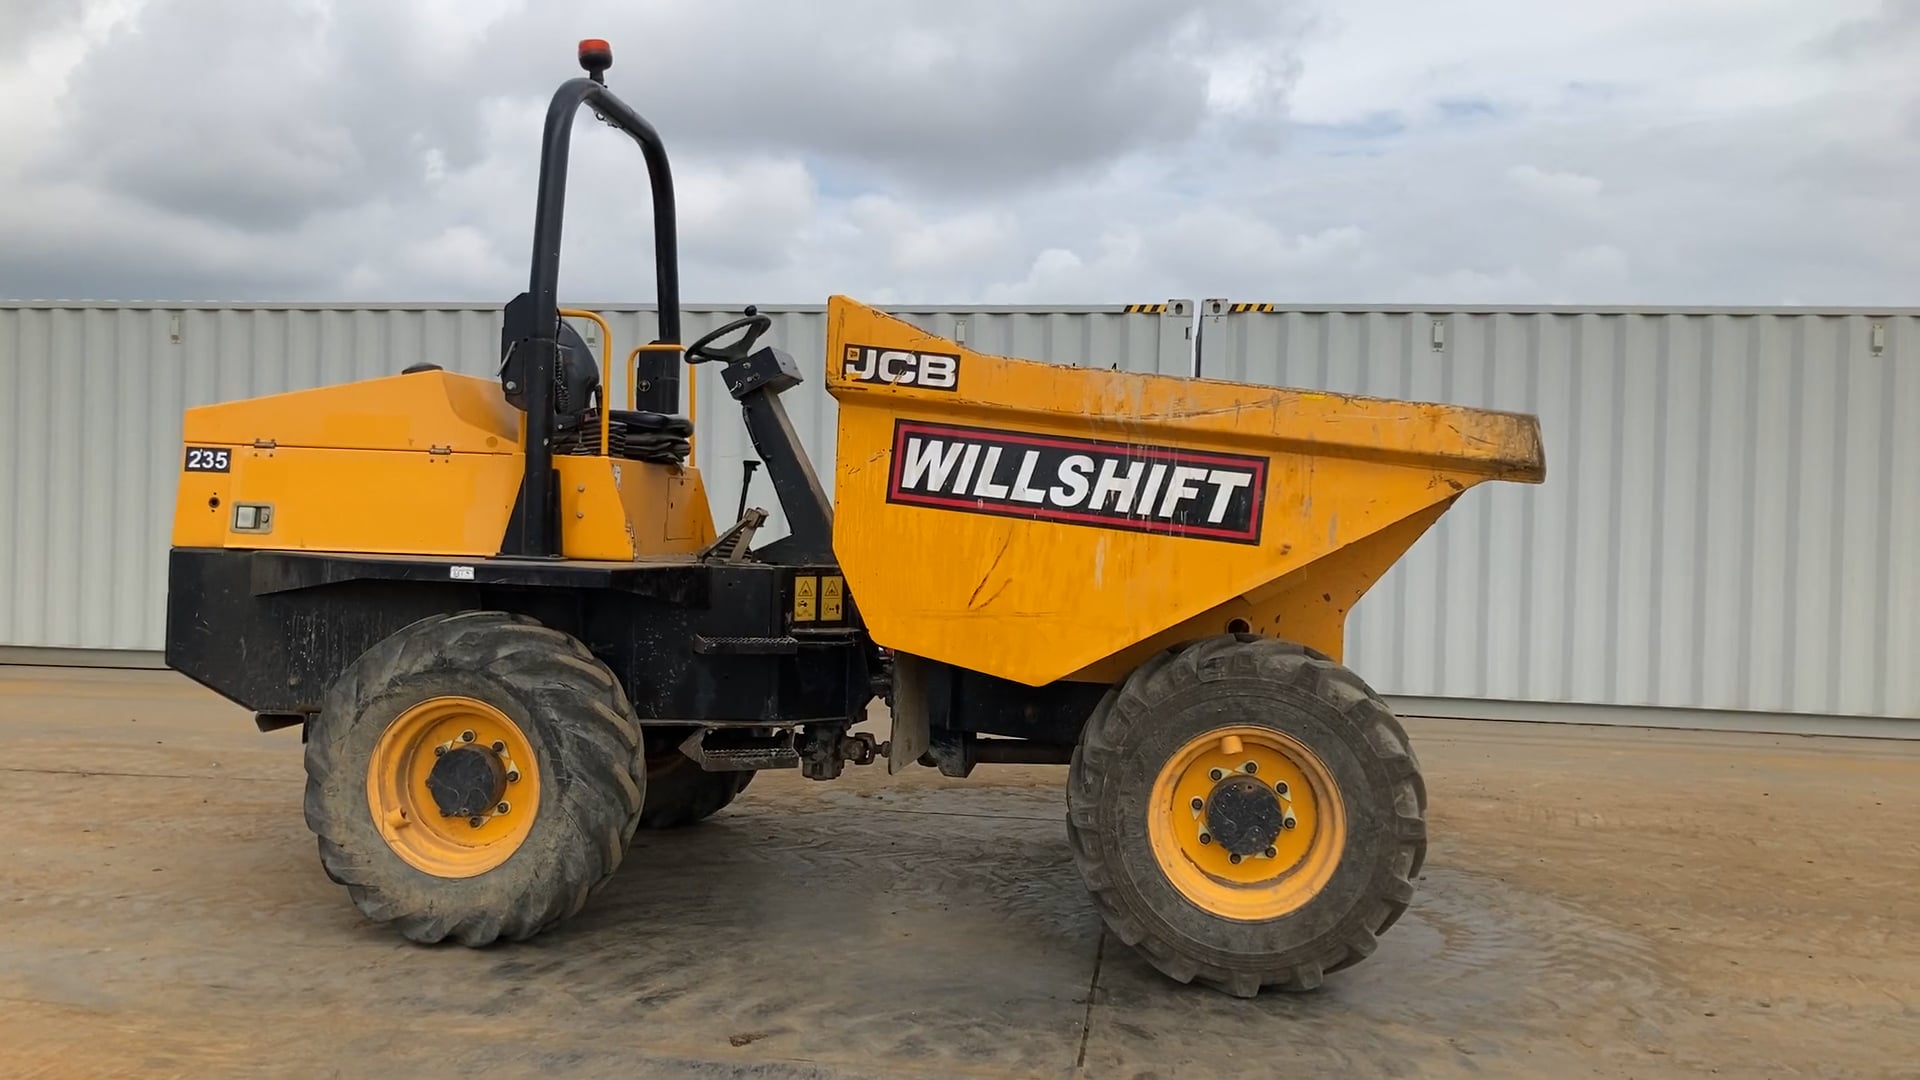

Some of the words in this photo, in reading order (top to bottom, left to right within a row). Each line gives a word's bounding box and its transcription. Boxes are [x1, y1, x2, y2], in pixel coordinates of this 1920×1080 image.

[845, 348, 956, 388] JCB
[188, 450, 228, 470] 235
[901, 436, 1253, 524] WILLSHIFT
